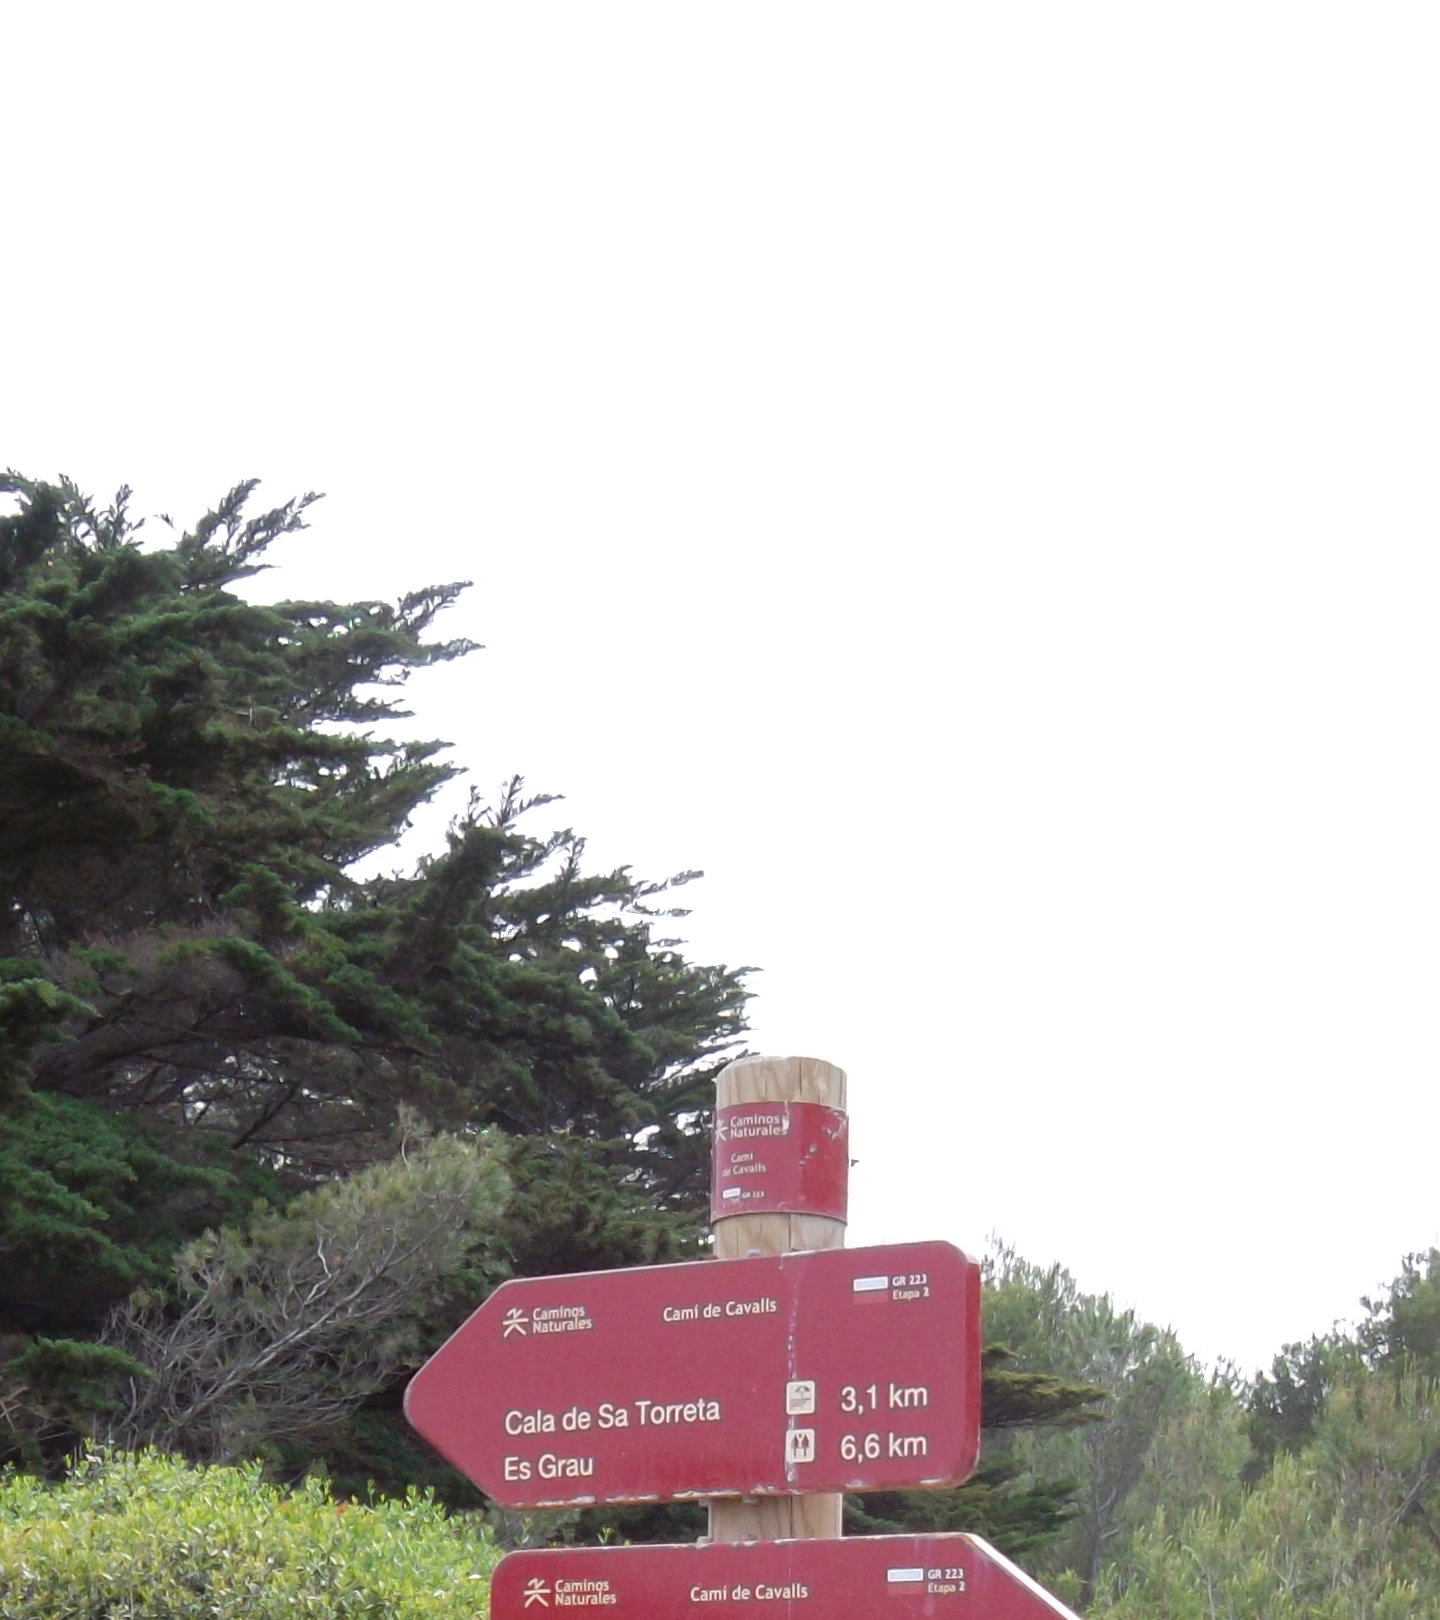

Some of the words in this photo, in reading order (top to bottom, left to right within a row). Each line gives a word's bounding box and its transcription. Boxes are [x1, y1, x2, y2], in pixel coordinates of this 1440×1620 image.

[730, 1113, 780, 1128] Caminos
[730, 1124, 788, 1140] Naturales
[732, 1163, 767, 1175] Cavalls
[892, 1275, 906, 1287] GR
[909, 1273, 927, 1285] 223
[892, 1289, 920, 1301] Etapa
[923, 1286, 930, 1297] 2
[532, 1306, 585, 1321] Caminos
[703, 1302, 721, 1318] de
[725, 1297, 777, 1316] Cavalls
[532, 1317, 592, 1334] Naturales
[841, 1384, 877, 1415] 3,1
[889, 1382, 928, 1409] km
[505, 1409, 556, 1436] Cala
[561, 1406, 592, 1432] de
[597, 1403, 629, 1429] Sa
[635, 1397, 721, 1426] Torreta
[840, 1433, 881, 1463] 6,6
[888, 1431, 928, 1458] km
[504, 1456, 532, 1481] Es
[538, 1453, 594, 1479] Grau
[927, 1569, 942, 1580] GR
[944, 1568, 964, 1579] 223
[554, 1579, 610, 1593] Caminos
[731, 1584, 751, 1600] de
[755, 1582, 808, 1600] Cavalls
[927, 1582, 956, 1595] Etapa
[959, 1580, 966, 1592] 2
[554, 1590, 617, 1607] Naturales
